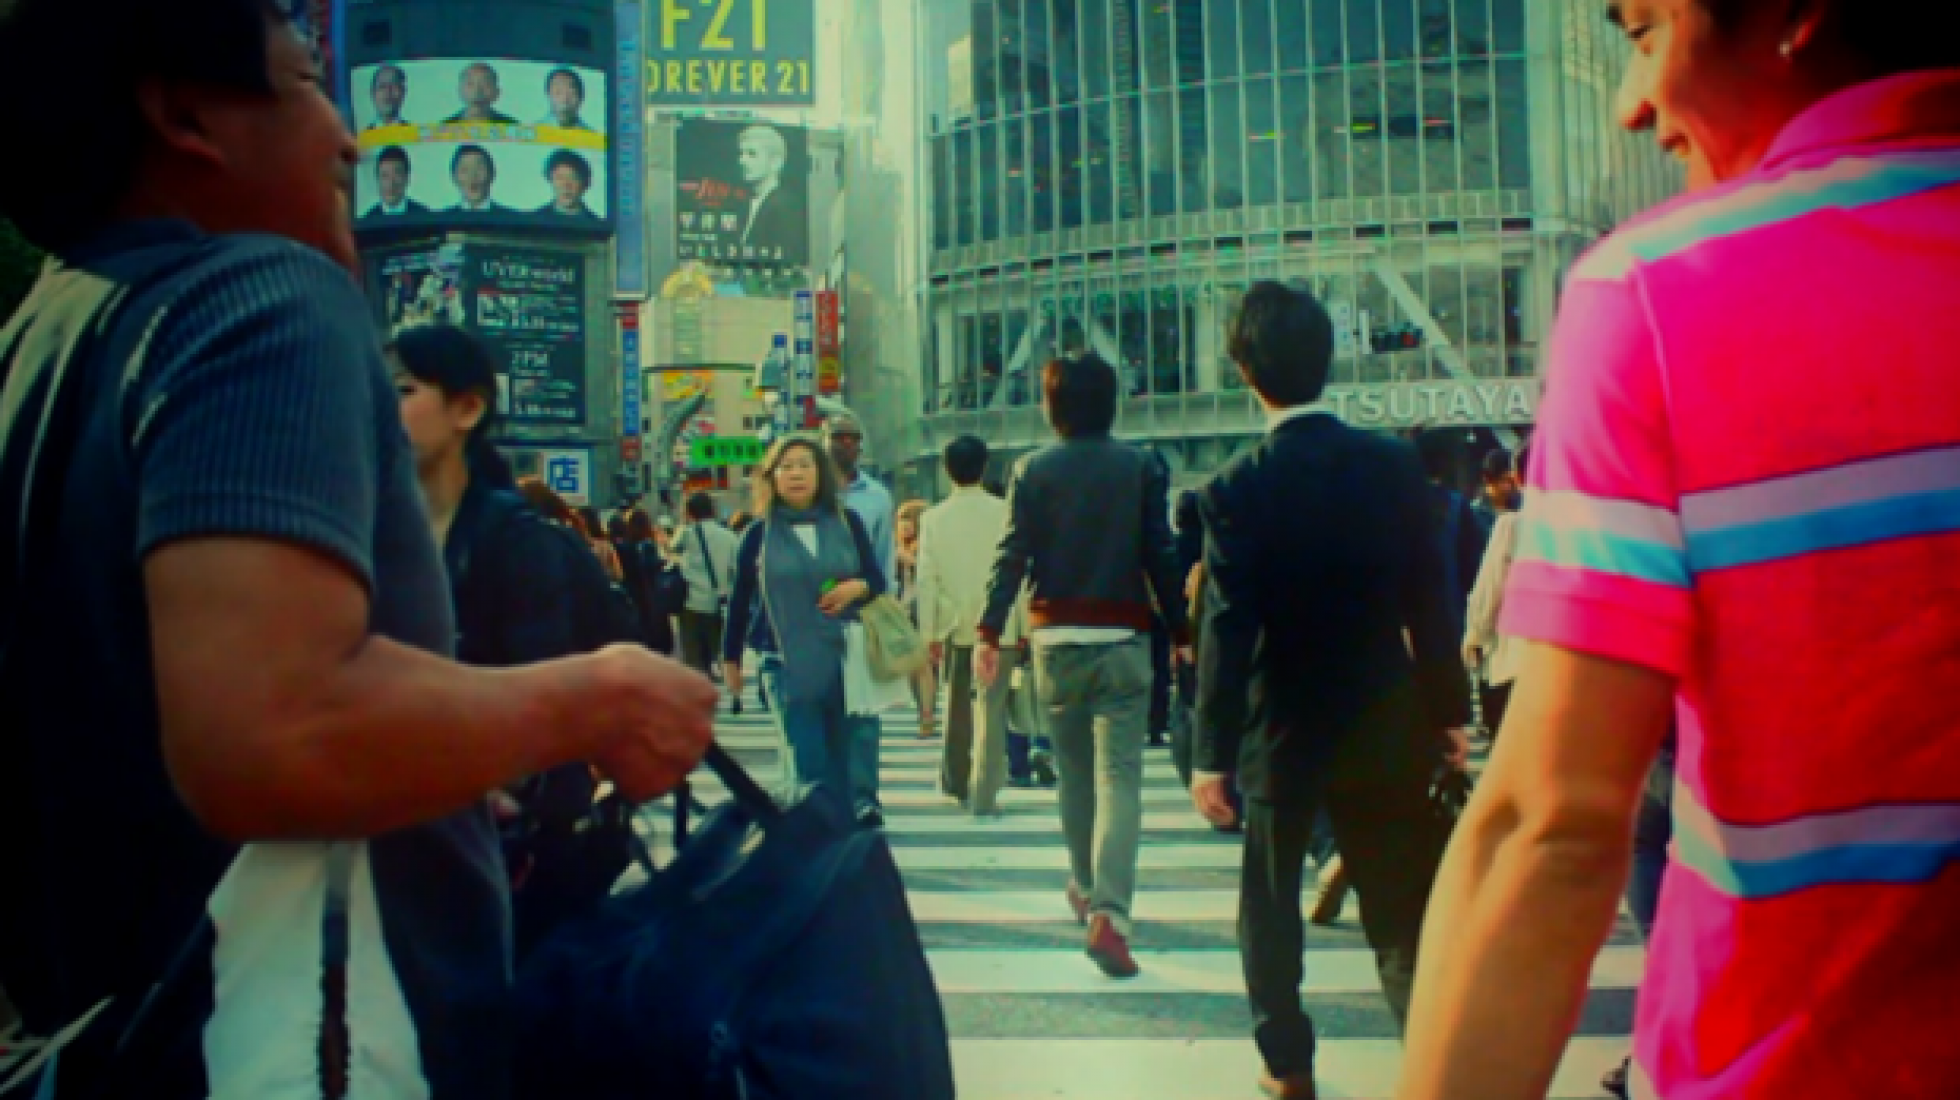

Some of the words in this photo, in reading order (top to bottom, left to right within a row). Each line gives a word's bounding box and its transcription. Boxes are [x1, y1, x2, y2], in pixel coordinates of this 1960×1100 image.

[662, 0, 766, 50] F21
[775, 59, 810, 94] 21
[1330, 384, 1534, 423] TSUTAYA
[549, 457, 580, 493] 店
